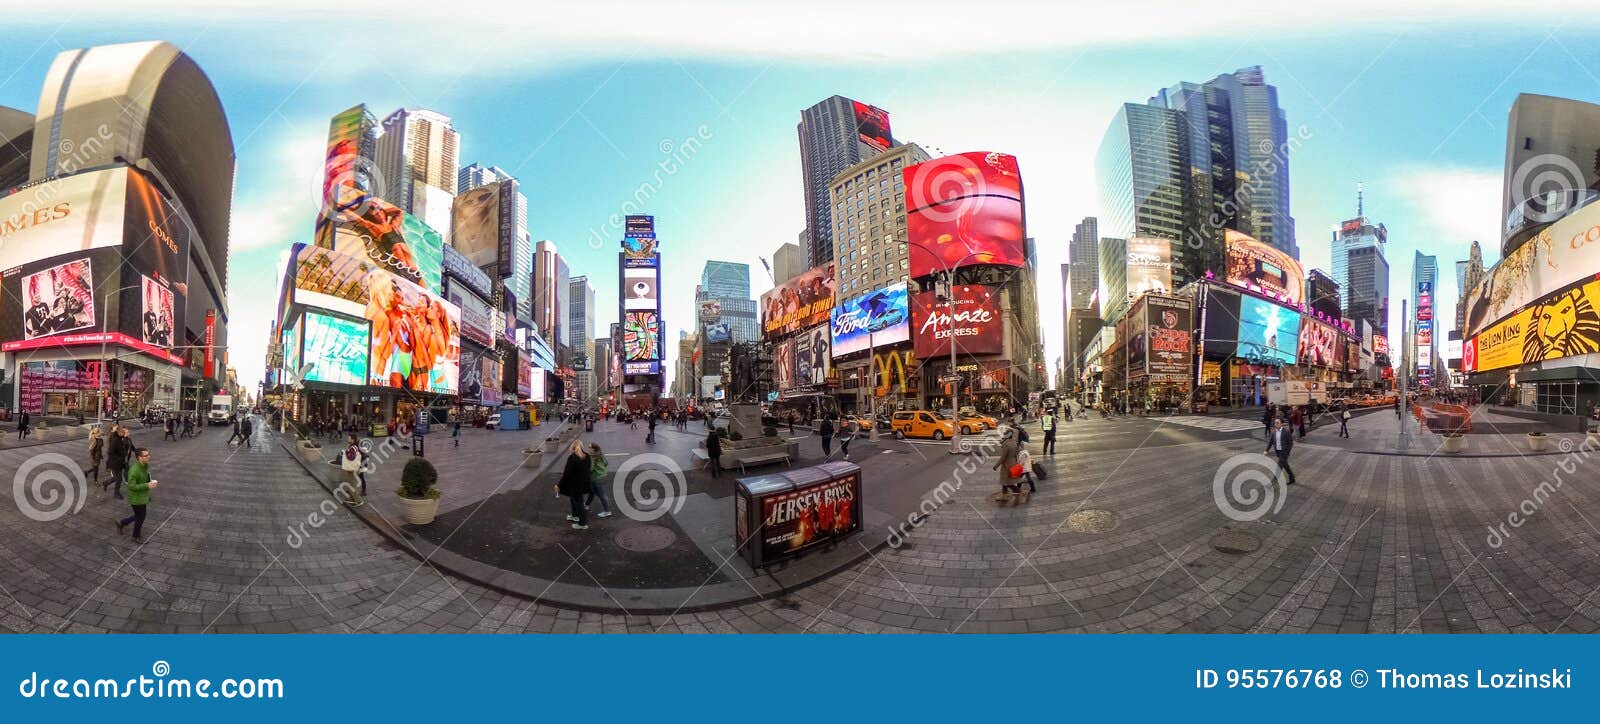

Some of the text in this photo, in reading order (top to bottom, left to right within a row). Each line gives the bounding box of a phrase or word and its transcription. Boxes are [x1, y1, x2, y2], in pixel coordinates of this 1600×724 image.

[149, 220, 178, 254] COMES
[833, 311, 871, 336] Ford
[920, 308, 992, 334] Amaze
[935, 328, 979, 339] EXPRESS
[1502, 324, 1520, 343] KING
[766, 483, 853, 526] JERSEY BOYS
